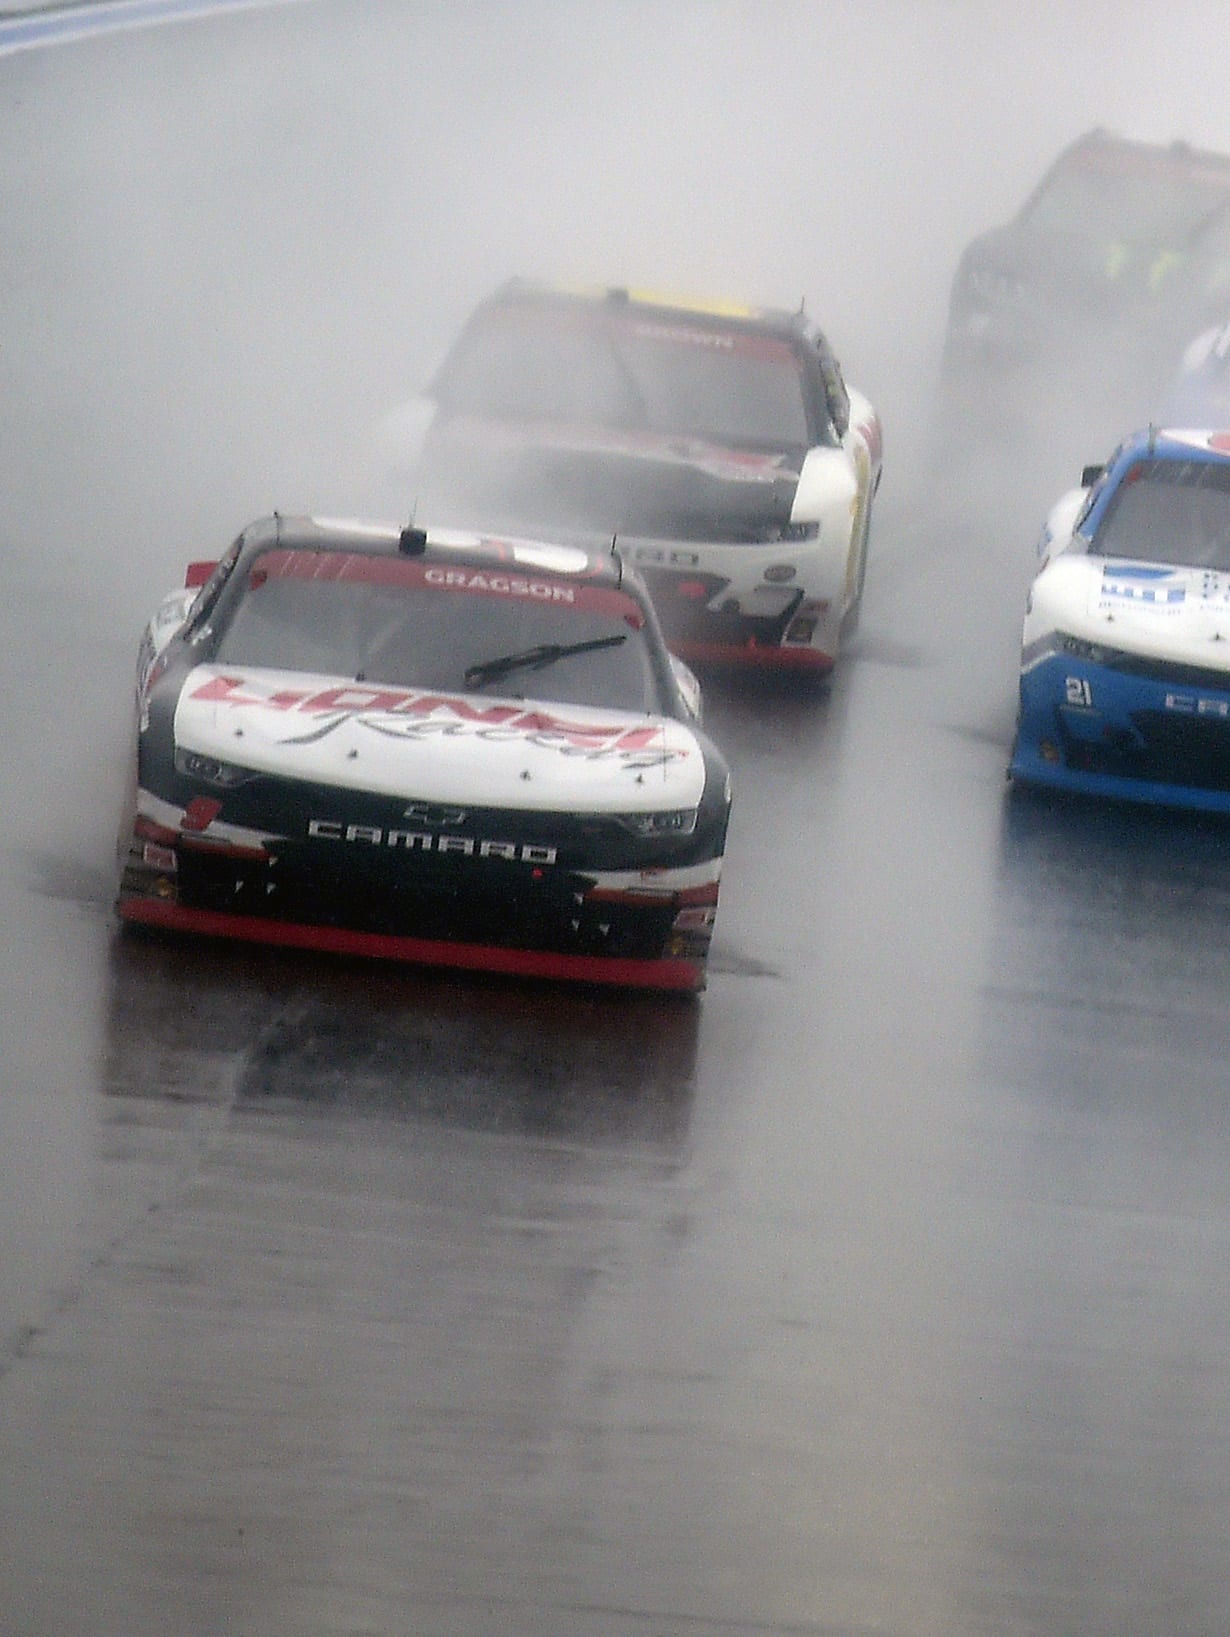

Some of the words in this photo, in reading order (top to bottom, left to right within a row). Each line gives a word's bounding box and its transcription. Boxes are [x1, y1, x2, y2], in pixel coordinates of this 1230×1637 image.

[424, 568, 575, 603] GRAGSON
[1065, 677, 1092, 705] 21
[308, 819, 558, 866] CAMARO
